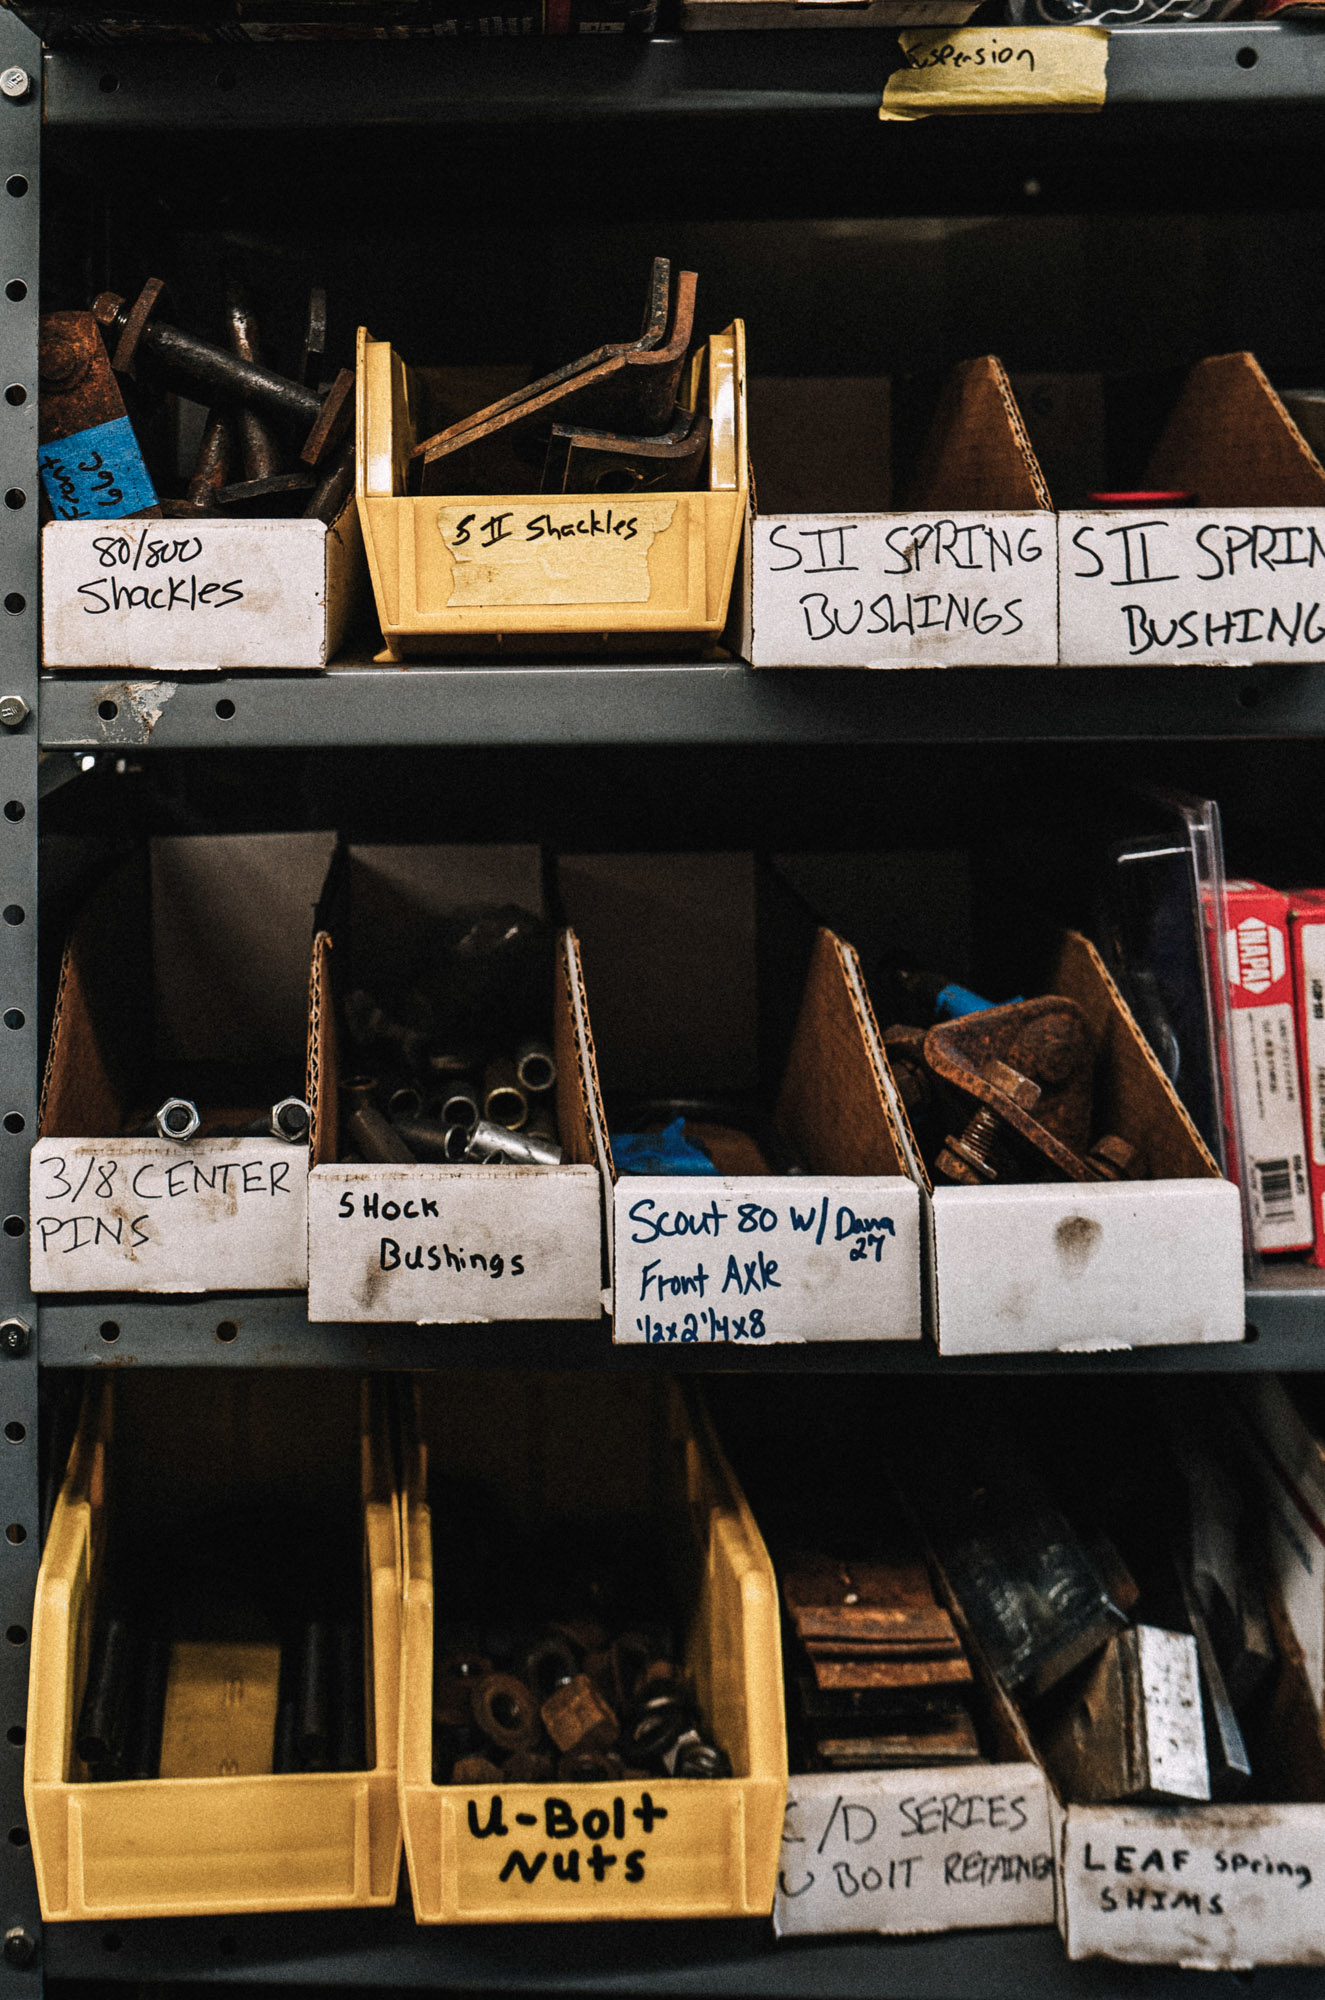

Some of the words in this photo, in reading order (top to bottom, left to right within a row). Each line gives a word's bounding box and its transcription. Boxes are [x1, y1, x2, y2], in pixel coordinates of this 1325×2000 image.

[526, 509, 638, 541] Shackles
[884, 519, 1042, 574] SPRING
[77, 575, 244, 614] Shackles
[799, 592, 1023, 640] BUSHINGS
[39, 1156, 118, 1203] 3/8
[132, 1160, 291, 1199] CENTER
[36, 1214, 149, 1254] PINS
[628, 1199, 728, 1243] Scout
[737, 1203, 778, 1232] 80
[640, 1259, 710, 1301] Front
[721, 1251, 782, 1295] Axle
[467, 1792, 668, 1840] U-Bolt
[899, 1793, 1028, 1837] SERIES
[499, 1844, 646, 1884] Nuts
[1084, 1842, 1190, 1874] LEAF
[1100, 1886, 1224, 1915] SHIMS
